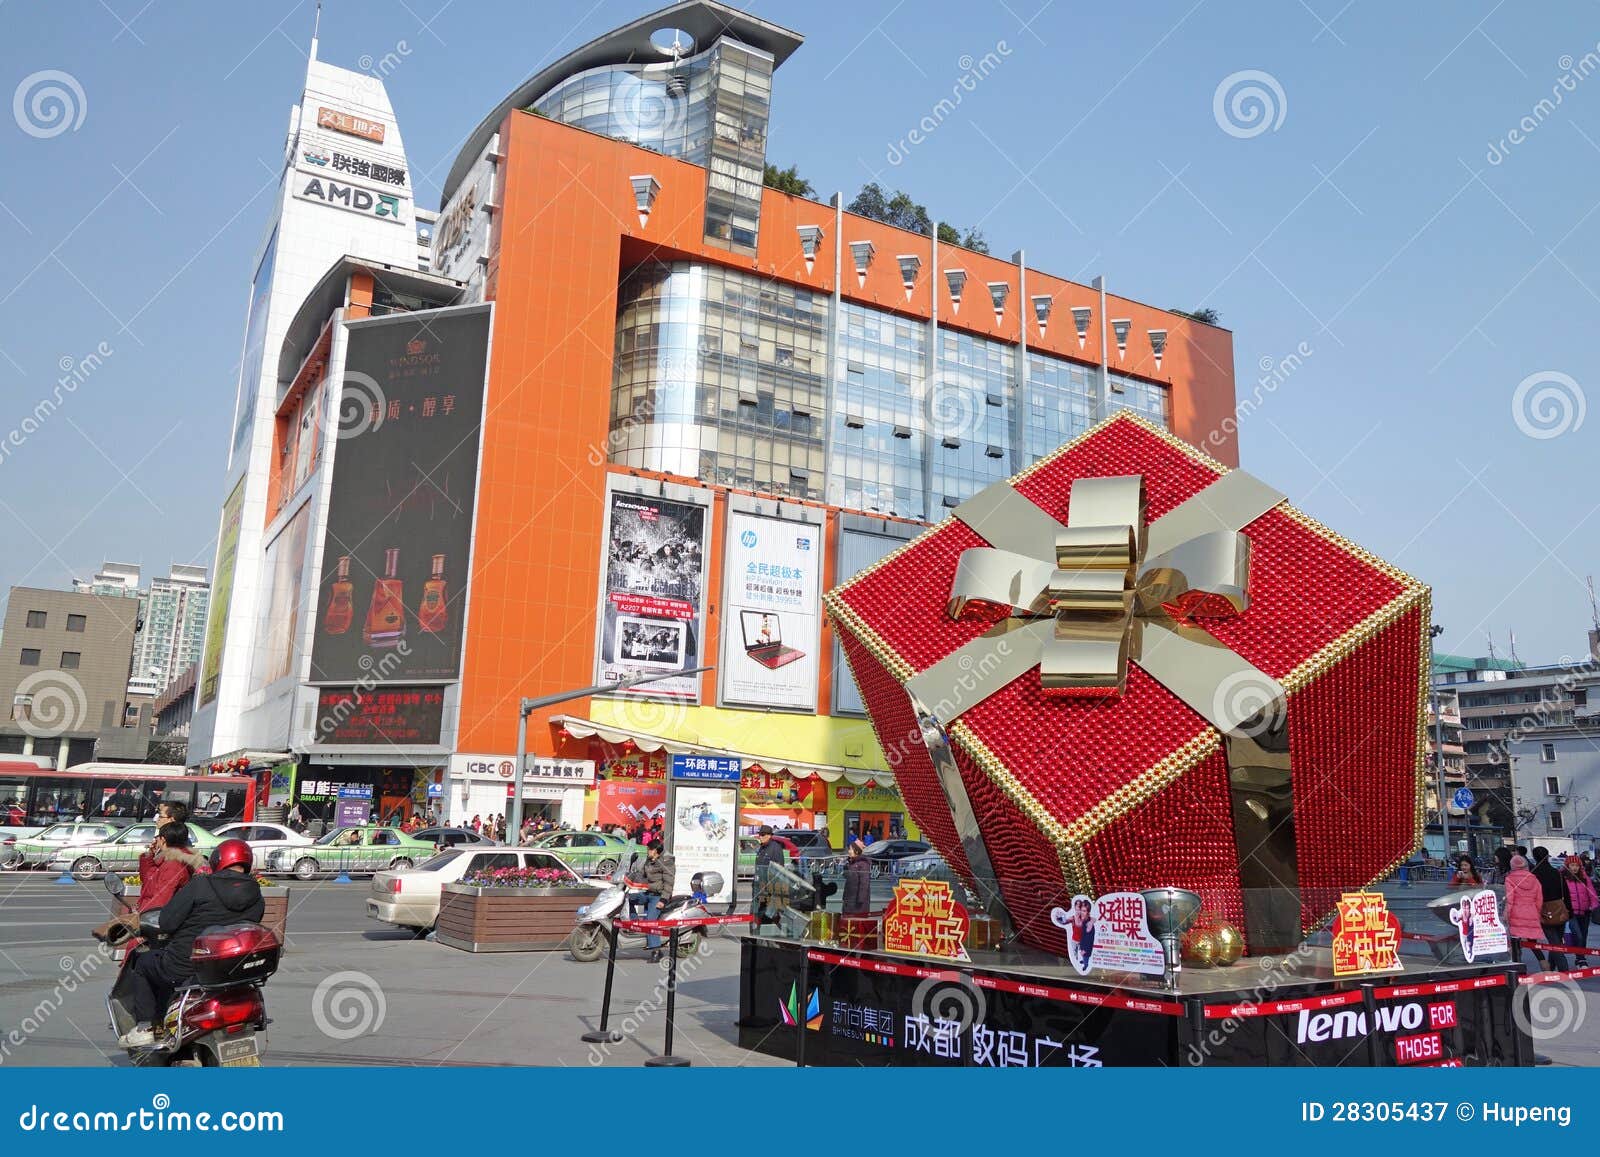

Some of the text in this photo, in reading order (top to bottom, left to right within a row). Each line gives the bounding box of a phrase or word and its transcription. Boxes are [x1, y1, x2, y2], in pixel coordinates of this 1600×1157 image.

[303, 178, 374, 211] AMD
[615, 500, 650, 511] lenovo
[466, 762, 495, 774] ICBC
[674, 758, 740, 772] 一环路南二段
[900, 881, 949, 919] 圣诞
[1344, 897, 1385, 932] 圣诞
[888, 920, 908, 938] 2013
[909, 917, 963, 955] 快乐
[1335, 938, 1353, 958] 2013
[1354, 931, 1398, 969] 快乐
[832, 1000, 894, 1035] 新尚集团
[1297, 1002, 1424, 1043] lenovo
[1430, 1005, 1454, 1025] FOR
[832, 1027, 865, 1040] SHINESUN
[1398, 1036, 1440, 1060] THOSE
